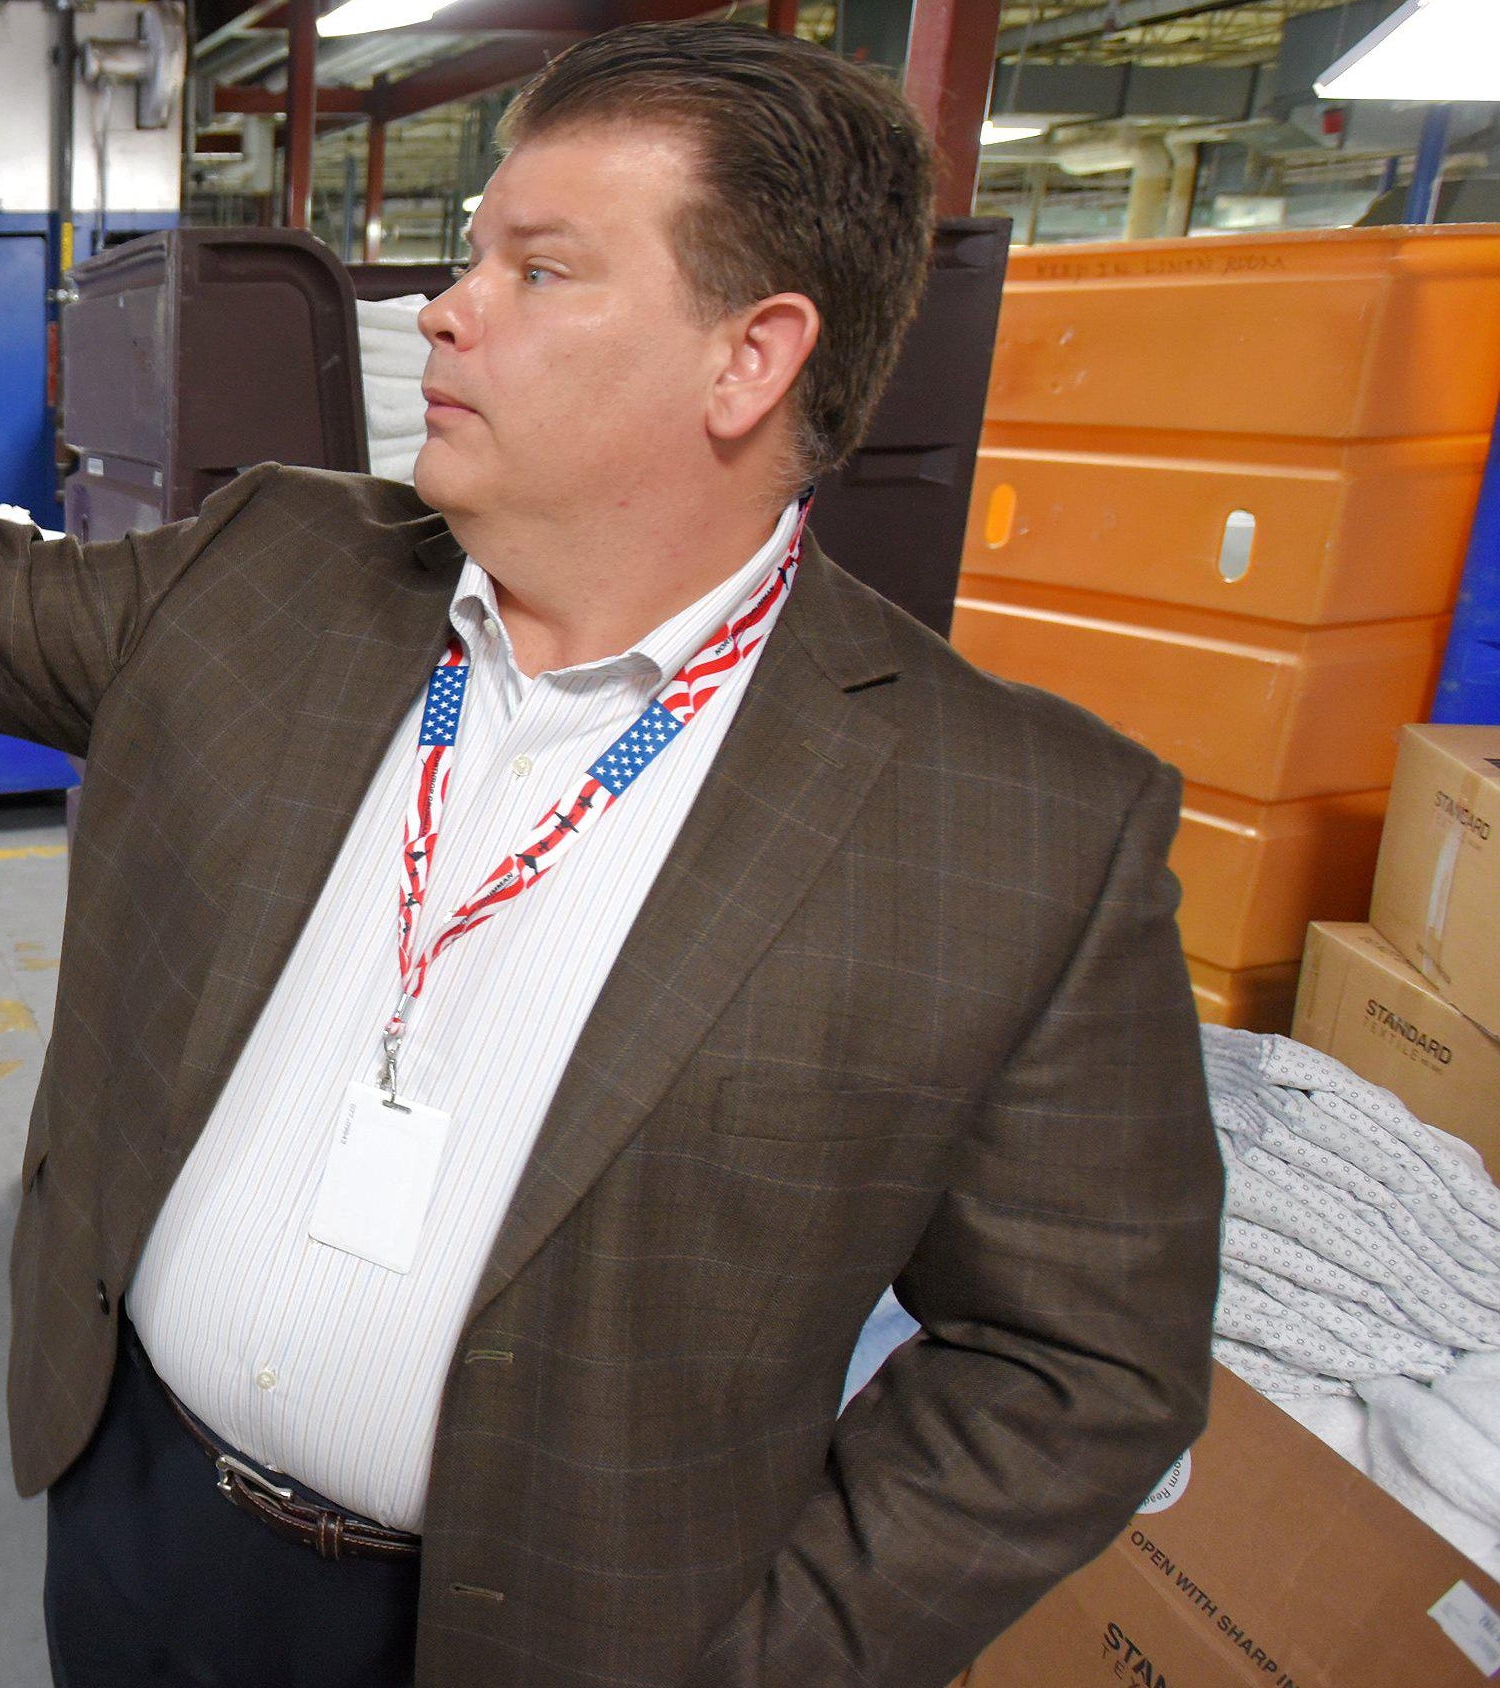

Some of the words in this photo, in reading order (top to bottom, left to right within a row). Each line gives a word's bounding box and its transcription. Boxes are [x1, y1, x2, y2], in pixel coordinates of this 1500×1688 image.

[1365, 999, 1453, 1065] STANDARD
[1131, 1530, 1176, 1577] OPEN
[1175, 1571, 1218, 1618] WITH
[1217, 1614, 1278, 1674] SHARP
